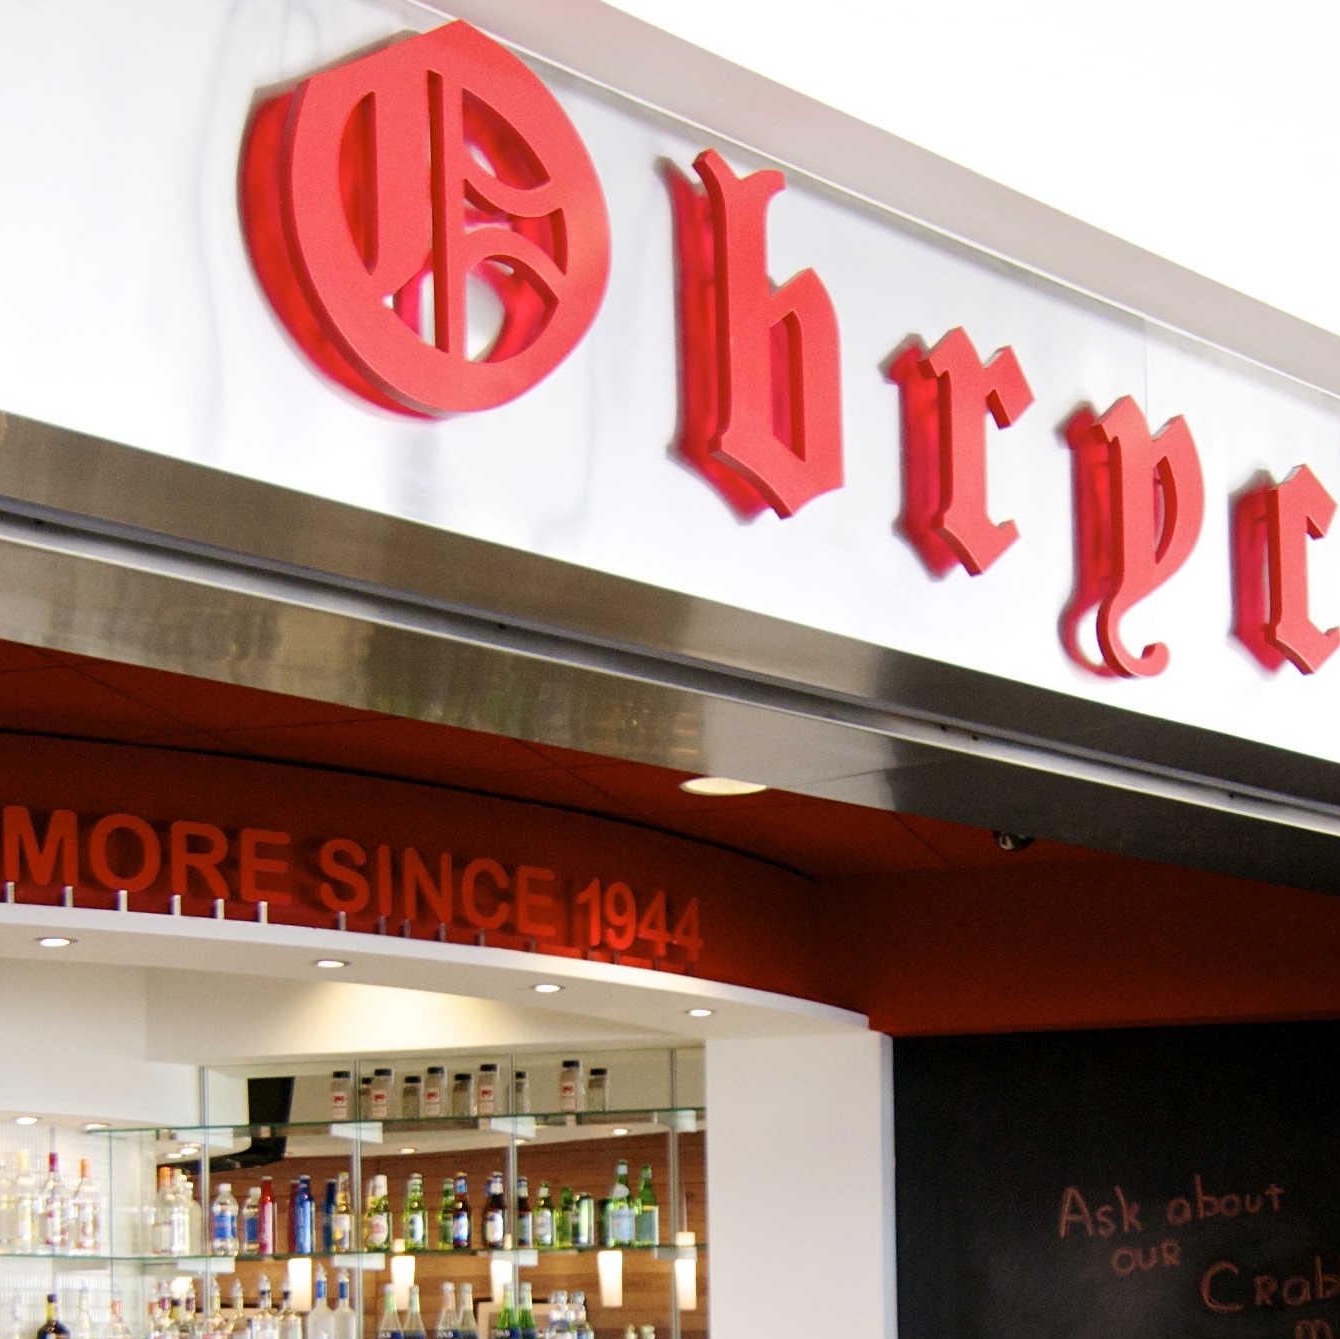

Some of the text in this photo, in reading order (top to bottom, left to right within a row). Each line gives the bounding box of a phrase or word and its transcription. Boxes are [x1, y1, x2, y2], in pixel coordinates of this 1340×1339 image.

[2, 805, 292, 906] MORE
[318, 838, 556, 937] SINCE
[577, 877, 704, 962] 1944
[1058, 1172, 1285, 1238] Ask about
